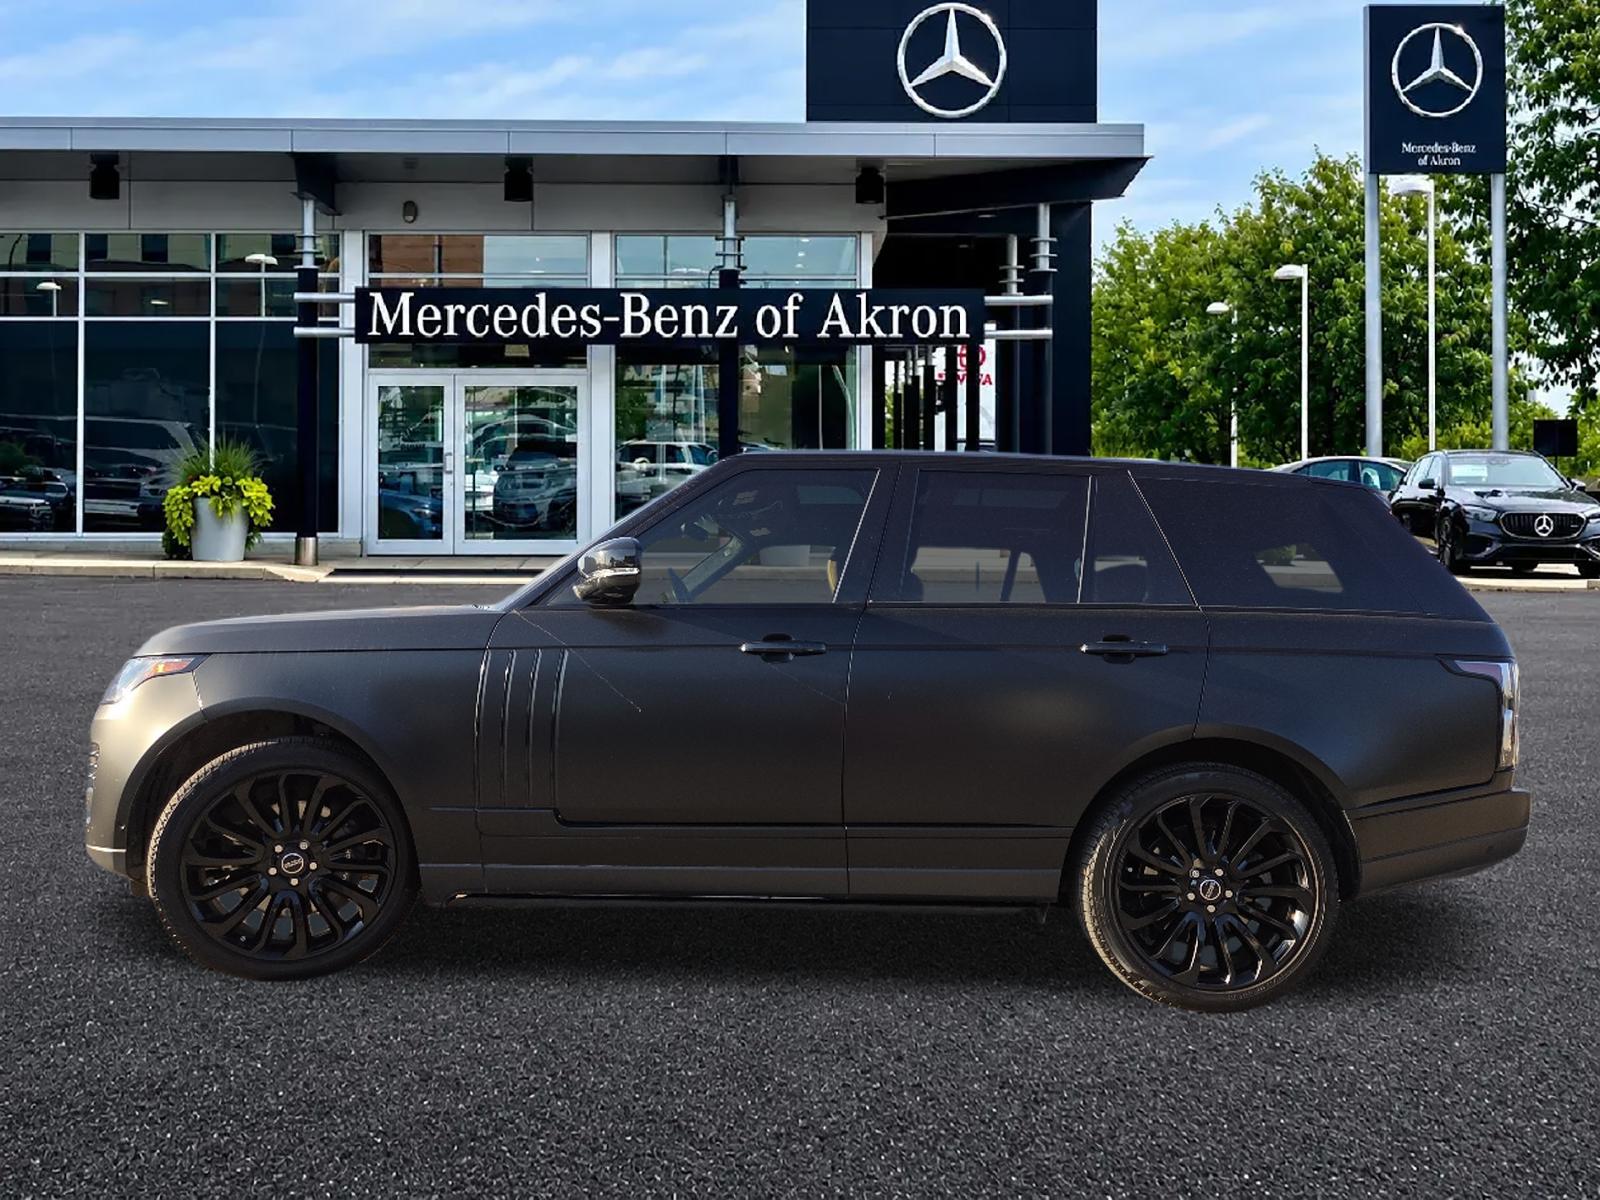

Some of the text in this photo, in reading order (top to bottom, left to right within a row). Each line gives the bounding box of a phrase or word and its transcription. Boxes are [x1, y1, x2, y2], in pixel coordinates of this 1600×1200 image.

[1401, 142, 1476, 153] Mercedes-Benz
[1417, 155, 1461, 166] of Akron
[367, 291, 971, 338] Mercedes-Benz of Akron
